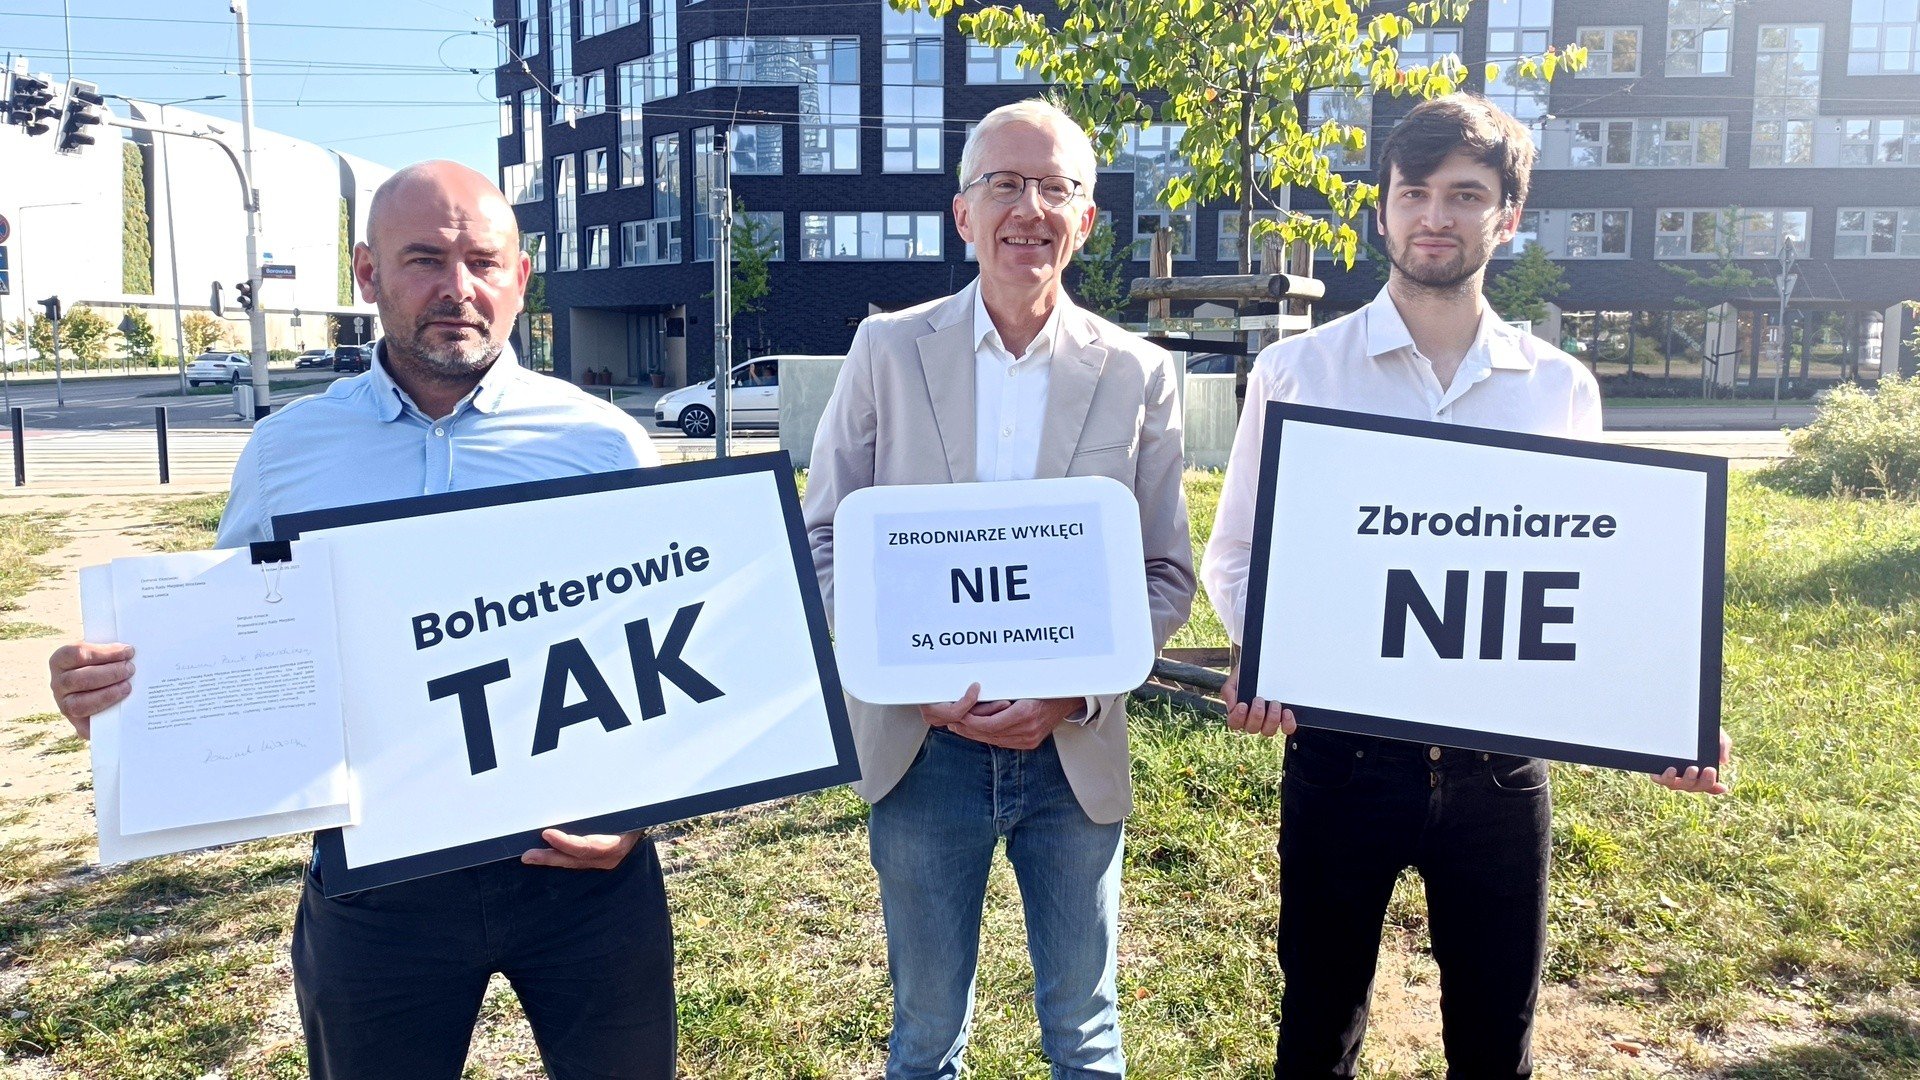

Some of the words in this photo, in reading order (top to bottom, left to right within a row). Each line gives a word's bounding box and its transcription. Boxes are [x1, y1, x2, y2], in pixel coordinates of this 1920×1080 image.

[888, 527, 1007, 546] ZBRODNIARZE
[1010, 522, 1084, 541] WYKLĘCI
[1357, 504, 1617, 539] Zbrodniarze
[411, 541, 710, 651] Bohaterowie
[950, 564, 1031, 604] NIE
[1380, 568, 1581, 662] NIE
[911, 633, 935, 651] SĄ
[938, 630, 998, 647] GODNI
[1003, 625, 1075, 645] PAMIĘCI
[426, 600, 726, 777] TAK
